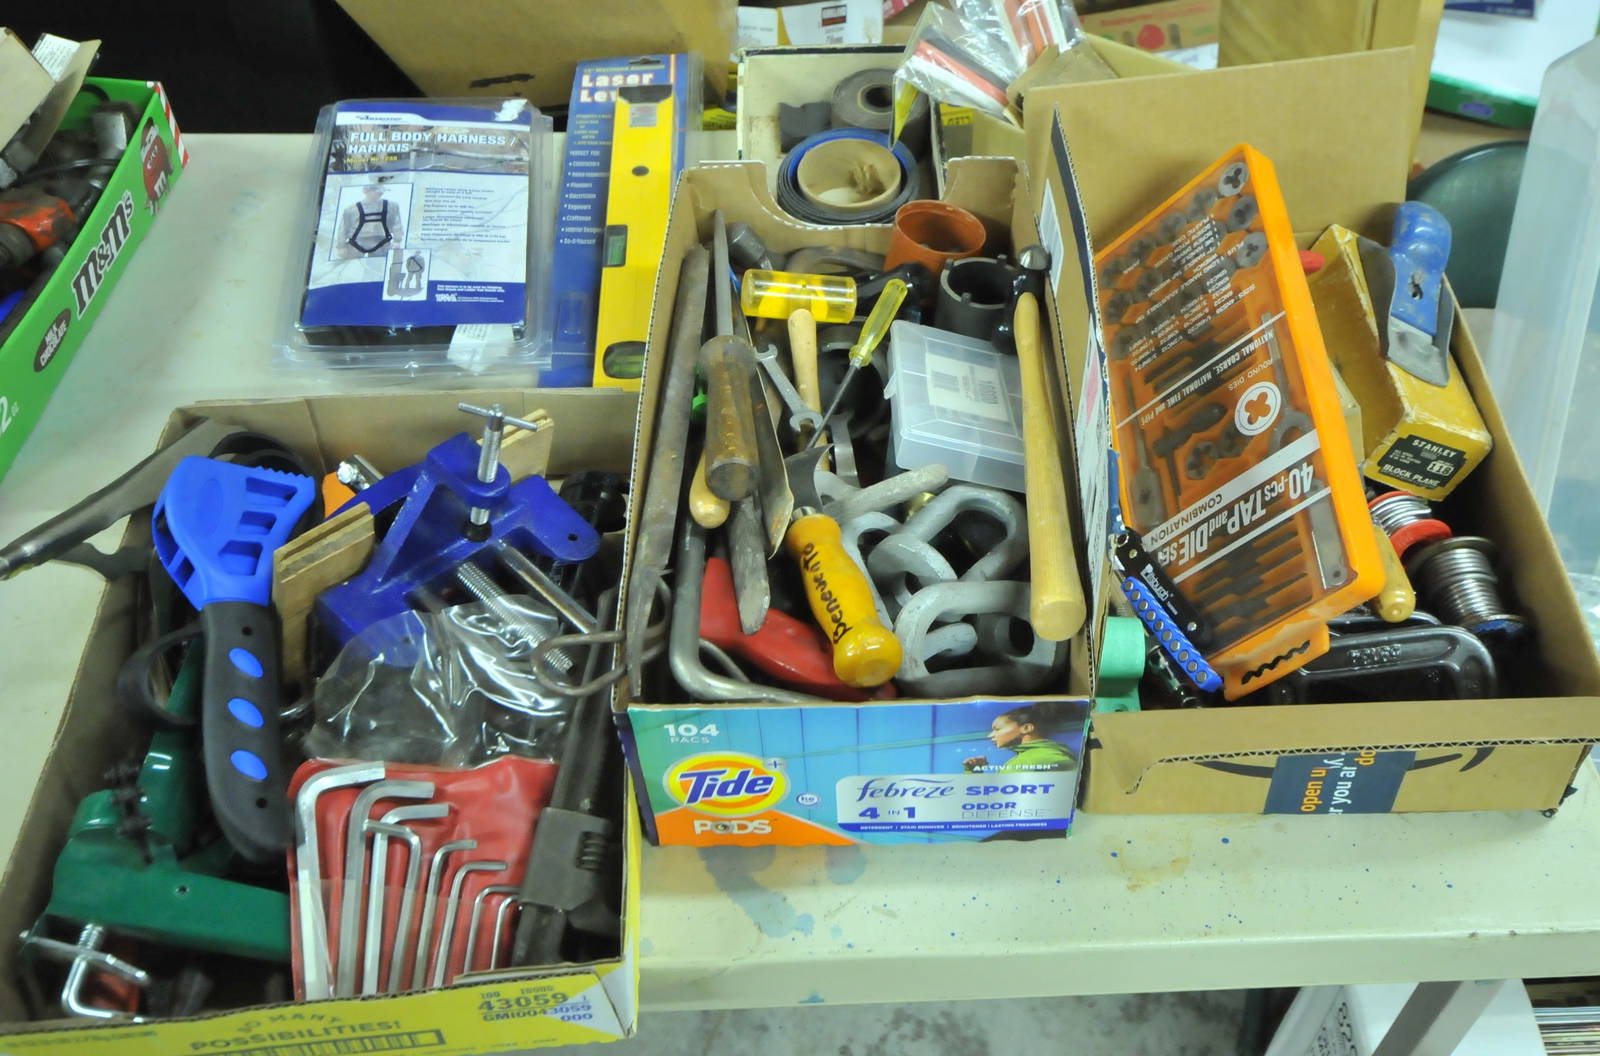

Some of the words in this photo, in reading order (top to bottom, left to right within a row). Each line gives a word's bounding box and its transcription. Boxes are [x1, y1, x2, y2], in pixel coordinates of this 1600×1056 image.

[582, 72, 654, 87] Laser
[580, 90, 618, 102] Lev
[348, 142, 410, 154] HARNAIS
[350, 132, 386, 143] FULL
[390, 132, 432, 143] BODY
[436, 134, 506, 146] HARNESS
[1182, 369, 1212, 399] NATIONAL
[1412, 439, 1456, 458] STANLEY
[1383, 464, 1410, 480] BLOCK
[1413, 472, 1440, 488] PLANE
[1150, 493, 1223, 546] COMBINATION
[1209, 511, 1228, 536] and
[1226, 493, 1266, 534] TAP
[1178, 526, 1210, 566] DIE
[663, 723, 720, 738] 104
[670, 736, 711, 744] PACS
[679, 768, 775, 804] Tide
[856, 777, 954, 802] febreze
[965, 783, 1056, 796] SPORT
[1301, 779, 1323, 812] open
[1332, 782, 1352, 805] you
[858, 806, 880, 819] 4
[902, 806, 916, 818] 1
[960, 802, 1017, 810] ODOR
[478, 991, 570, 1012] 43059
[191, 1022, 402, 1051] POSSIBILITIES!
